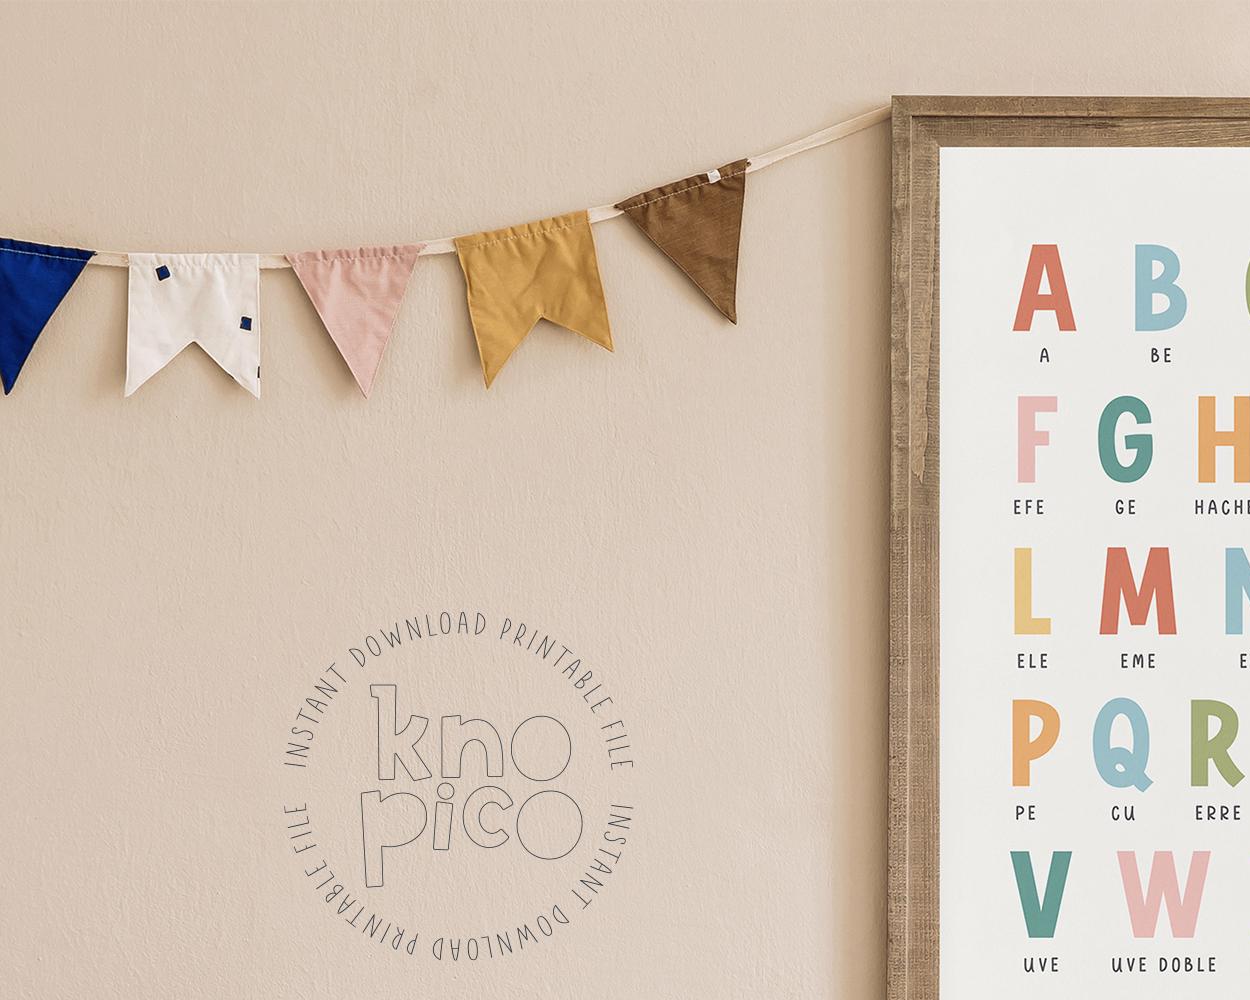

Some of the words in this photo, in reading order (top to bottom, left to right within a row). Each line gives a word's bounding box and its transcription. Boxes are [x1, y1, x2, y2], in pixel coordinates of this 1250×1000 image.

[1011, 243, 1078, 333] A
[1134, 243, 1188, 332] B
[1039, 347, 1050, 364] A
[1150, 347, 1172, 364] BE
[1017, 395, 1058, 484] F
[1097, 395, 1154, 484] G
[1013, 498, 1045, 516] EFE
[1114, 498, 1136, 515] GE
[1013, 546, 1052, 636] L
[1098, 546, 1178, 636] M
[1017, 652, 1048, 669] ELE
[1120, 652, 1156, 669] EME
[1011, 698, 1061, 788] P
[1092, 697, 1154, 793] Q
[1190, 698, 1246, 789] R
[1015, 804, 1036, 821] PE
[1111, 804, 1136, 822] CU
[1195, 804, 1241, 821] ERRE
[1009, 850, 1073, 939] V
[1116, 850, 1212, 939] W
[1023, 956, 1059, 974] UVE
[1111, 956, 1147, 974] UVE
[1158, 956, 1217, 974] DOBLE
